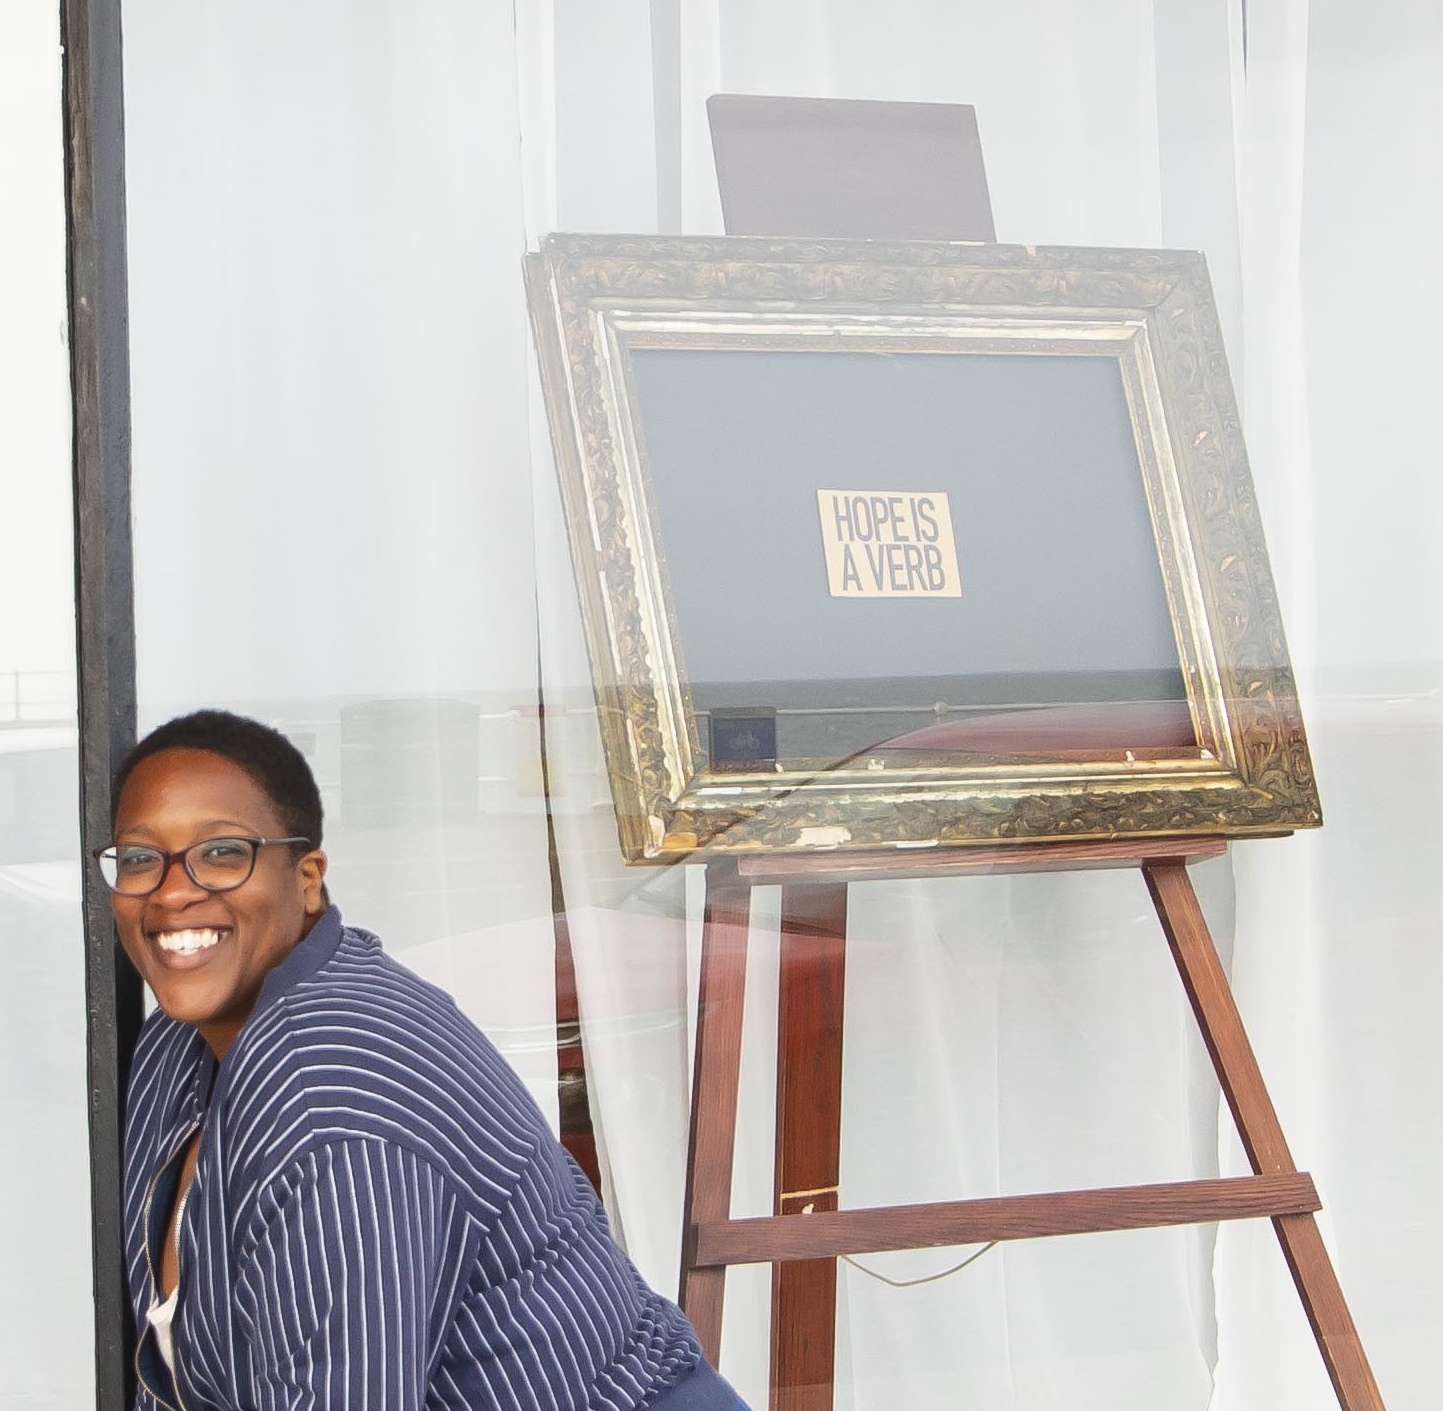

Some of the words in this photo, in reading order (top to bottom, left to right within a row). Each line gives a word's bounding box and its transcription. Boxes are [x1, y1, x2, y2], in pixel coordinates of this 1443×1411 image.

[832, 496, 910, 542] HOPE
[909, 497, 939, 542] IS
[843, 544, 864, 591] A
[865, 544, 946, 591] VERB
